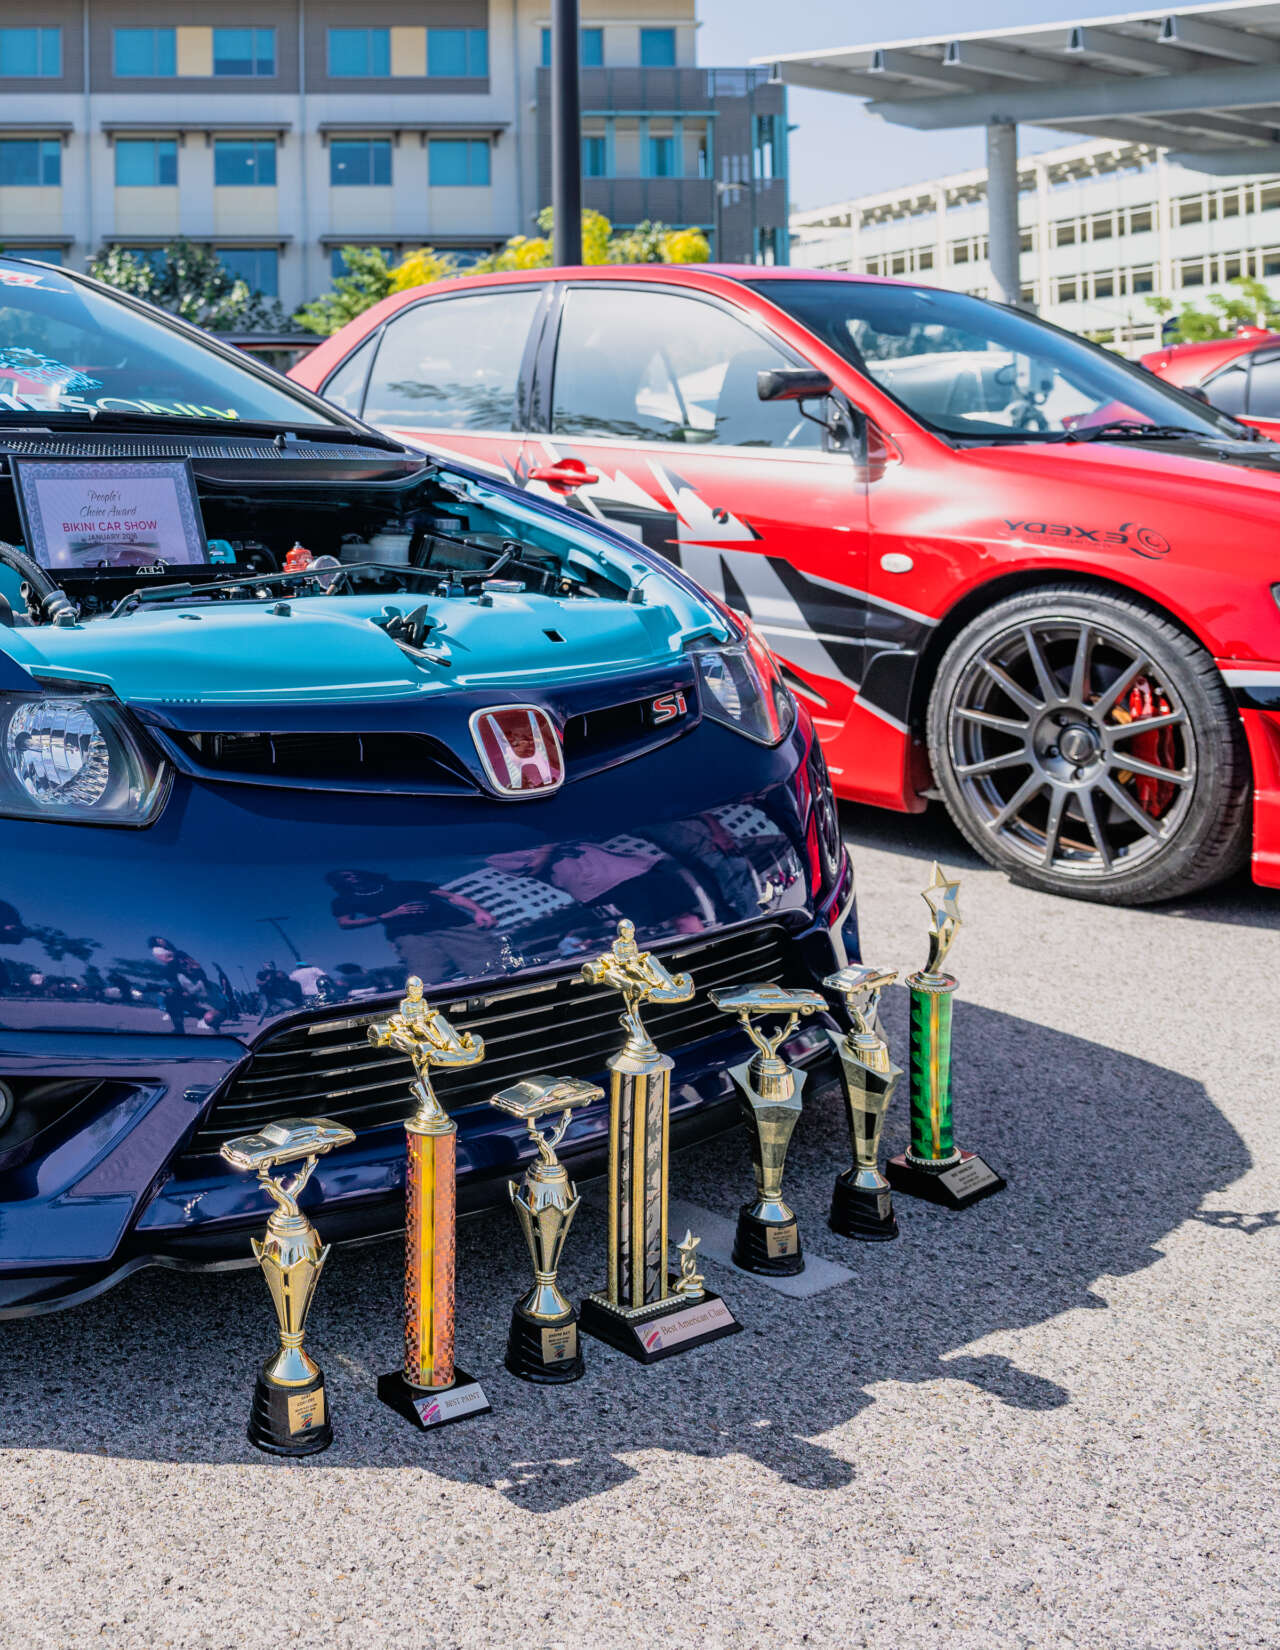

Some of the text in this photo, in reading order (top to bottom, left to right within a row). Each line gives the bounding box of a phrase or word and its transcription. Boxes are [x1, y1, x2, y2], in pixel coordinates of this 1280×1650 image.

[88, 489, 122, 504] People's
[80, 505, 137, 518] Choice Award
[62, 520, 157, 533] BIKINI CAR SHOW
[136, 566, 165, 575] AEM
[652, 690, 688, 725] Si
